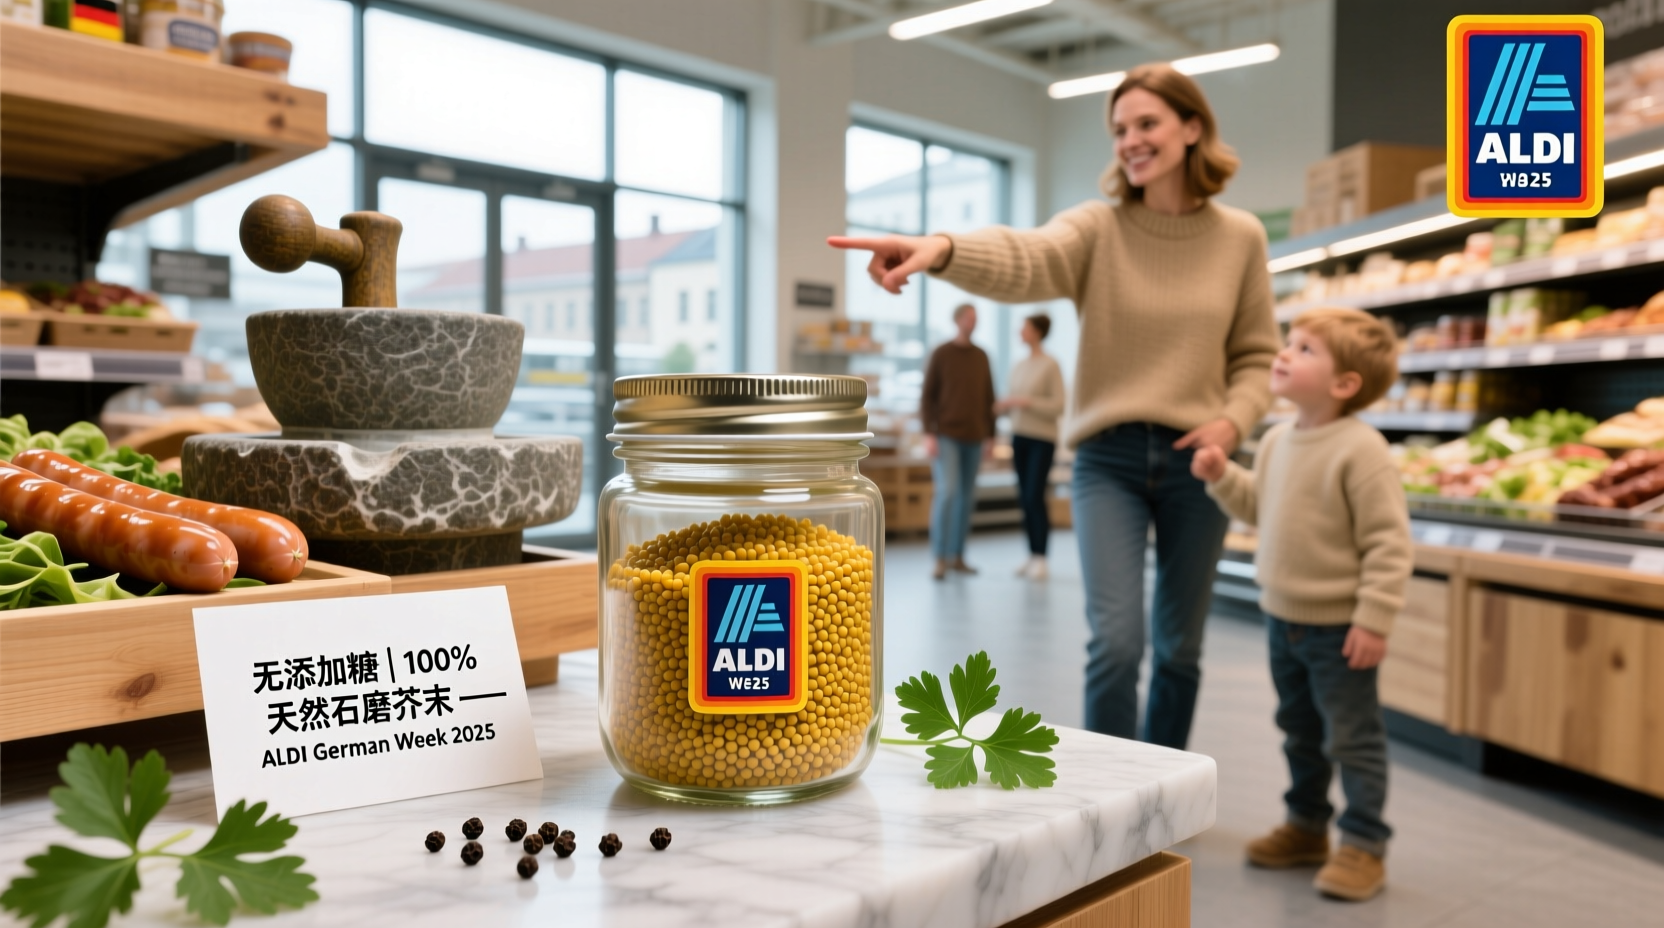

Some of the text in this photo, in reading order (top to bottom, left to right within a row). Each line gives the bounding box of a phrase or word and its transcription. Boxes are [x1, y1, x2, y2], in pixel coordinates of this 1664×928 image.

[253, 650, 380, 695] 无添加糖
[403, 643, 478, 675] 100%
[712, 648, 785, 672] ALDI
[267, 684, 454, 736] 天然石磨芥末
[261, 722, 496, 769] ALDI German Week 2025
